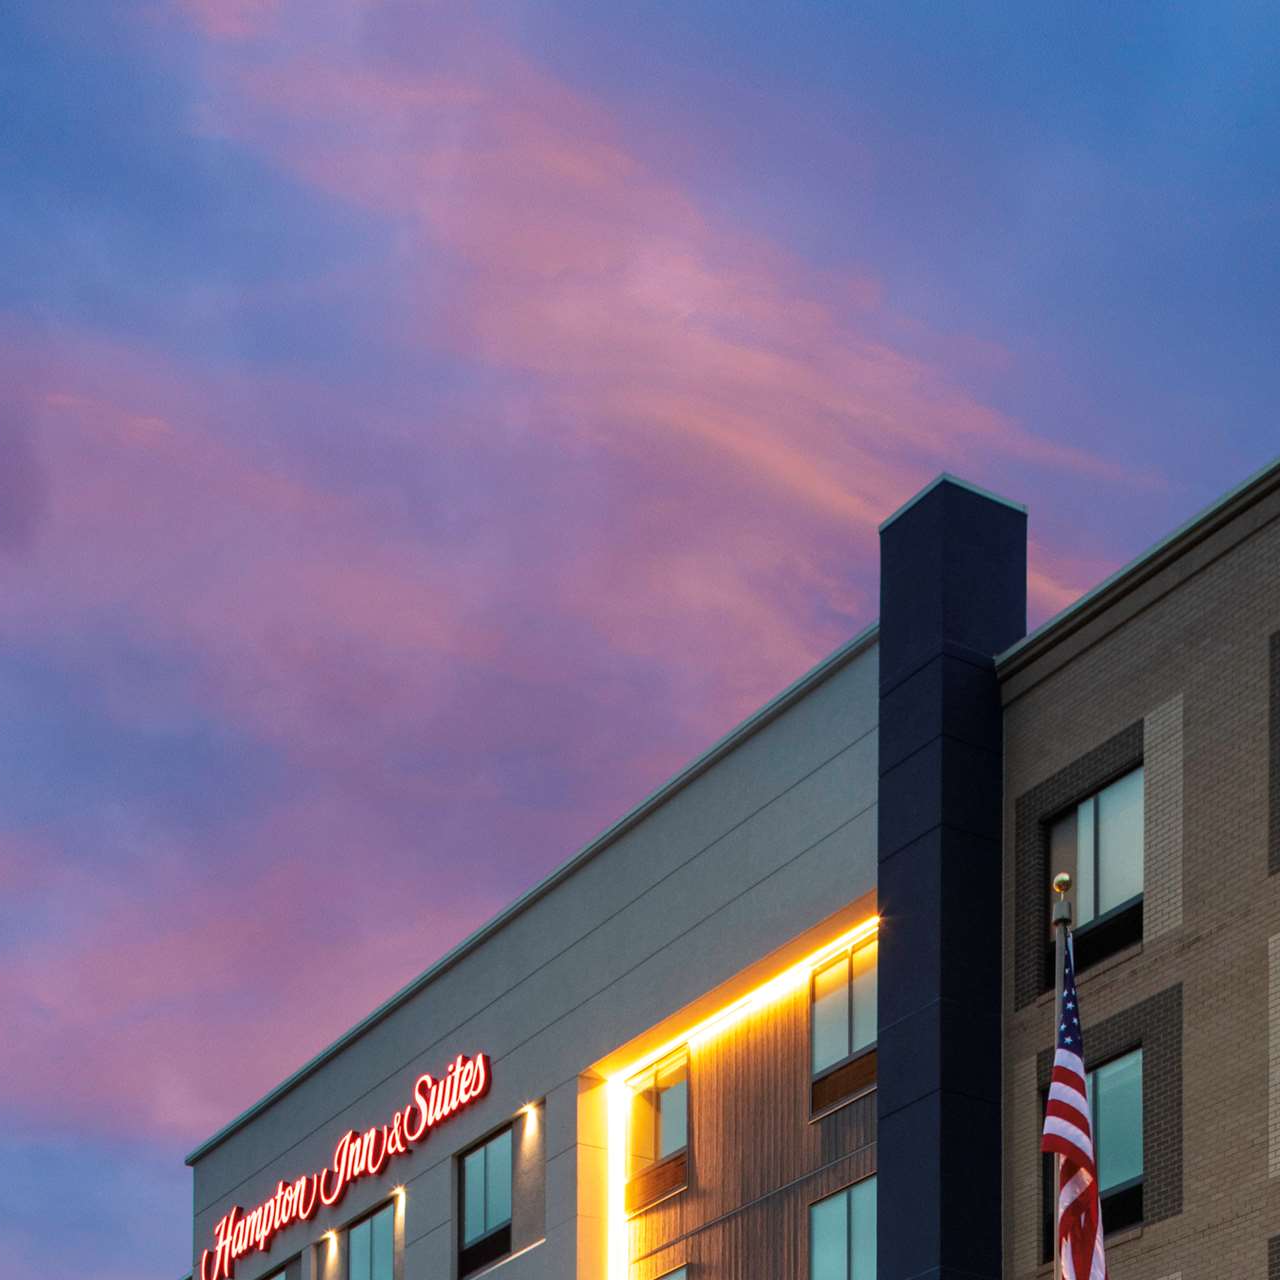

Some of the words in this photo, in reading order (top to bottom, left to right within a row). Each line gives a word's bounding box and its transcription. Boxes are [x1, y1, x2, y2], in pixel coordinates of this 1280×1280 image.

[320, 1124, 388, 1205] Inn
[387, 1111, 408, 1155] &
[403, 1052, 489, 1142] Suites
